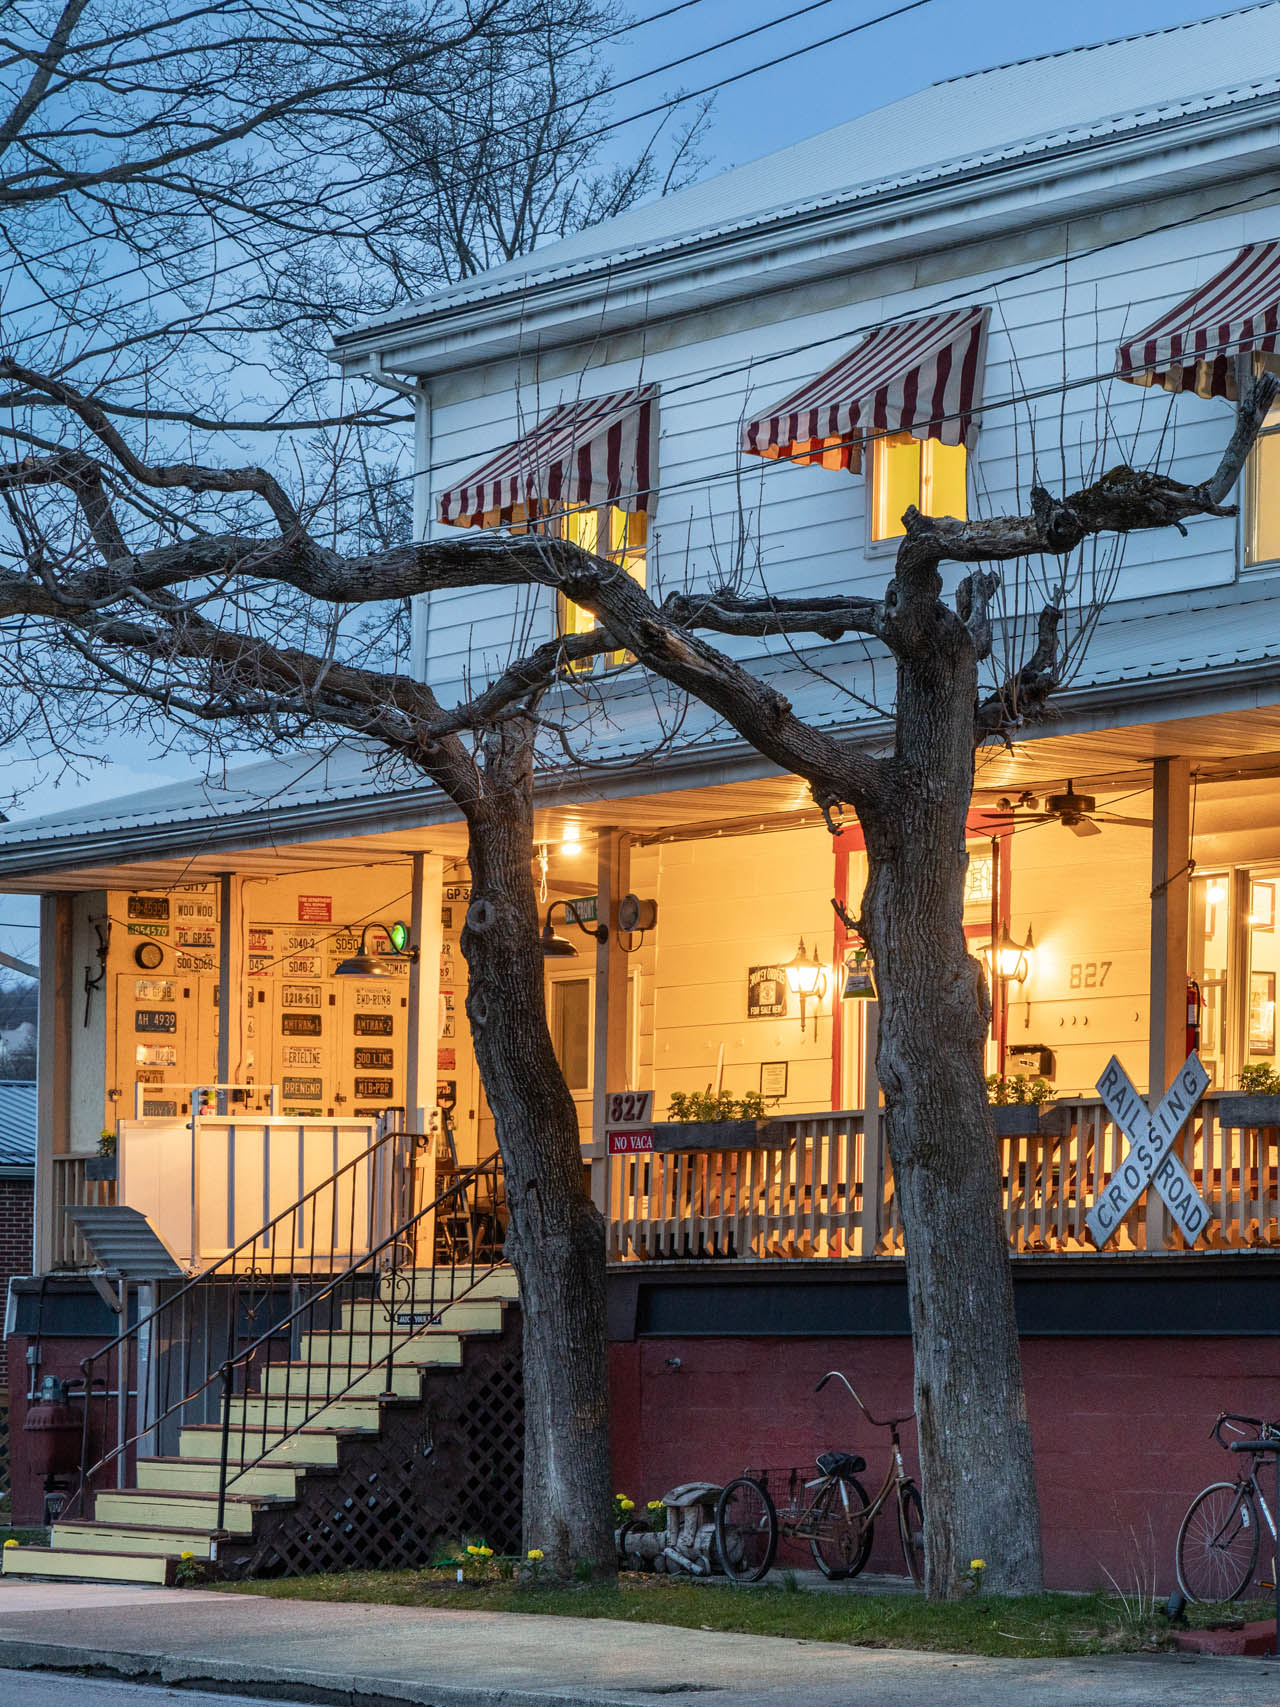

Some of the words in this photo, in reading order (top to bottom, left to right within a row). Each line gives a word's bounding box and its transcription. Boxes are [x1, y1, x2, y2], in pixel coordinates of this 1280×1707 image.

[447, 888, 460, 899] GP
[178, 905, 193, 917] WOO
[197, 905, 212, 917] WOO
[178, 932, 188, 943] PC
[193, 932, 212, 944] GP35
[335, 938, 358, 950] SD50
[376, 941, 386, 952] PC
[177, 957, 192, 969] SOO
[1070, 961, 1112, 989] 827
[285, 992, 319, 1005] 1218-611
[137, 1013, 149, 1025] AH
[154, 1013, 176, 1026] 4939
[288, 1051, 321, 1064] ERIELINE
[356, 1053, 371, 1064] SOO
[373, 1053, 392, 1065] LINE
[284, 1082, 321, 1094] RRENGNR
[611, 1094, 649, 1122] 827
[614, 1136, 627, 1150] NO
[1100, 1065, 1140, 1139] RAIL
[1157, 1158, 1203, 1233] ROAD
[1097, 1070, 1197, 1229] CROSSING
